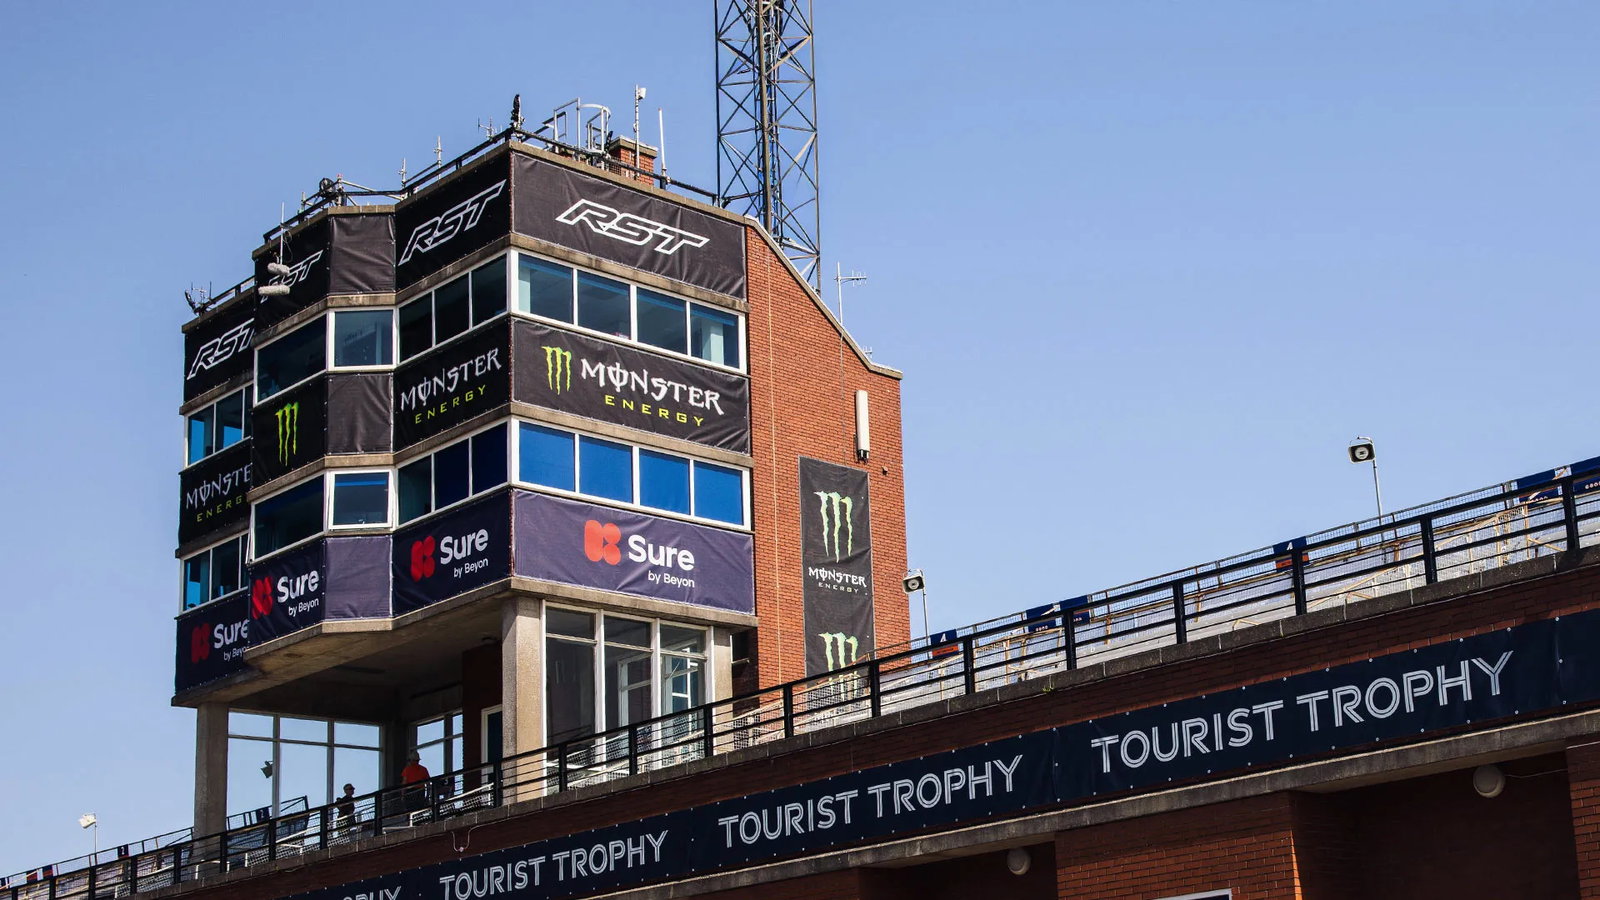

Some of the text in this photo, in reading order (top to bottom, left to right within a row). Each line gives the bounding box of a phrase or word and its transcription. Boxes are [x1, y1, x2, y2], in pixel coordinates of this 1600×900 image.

[398, 178, 507, 266] RST
[555, 198, 710, 255] RST
[415, 384, 486, 424] ENERGY
[604, 394, 704, 427] ENERGY
[186, 462, 252, 510] MONSTE
[196, 495, 243, 522] ENERG
[440, 528, 489, 565] Sure
[628, 534, 696, 571] Sure
[453, 557, 489, 578] by Beyon
[647, 570, 696, 589] by Beyon
[277, 569, 320, 604] Sure
[818, 581, 859, 594] ENERGY
[288, 597, 320, 618] by Beyon
[223, 651, 232, 662] by
[1091, 650, 1514, 773] TOURIST TROPHY
[718, 754, 1023, 848] TOURIST TROPHY
[439, 829, 669, 900] TOURIST TROPHY
